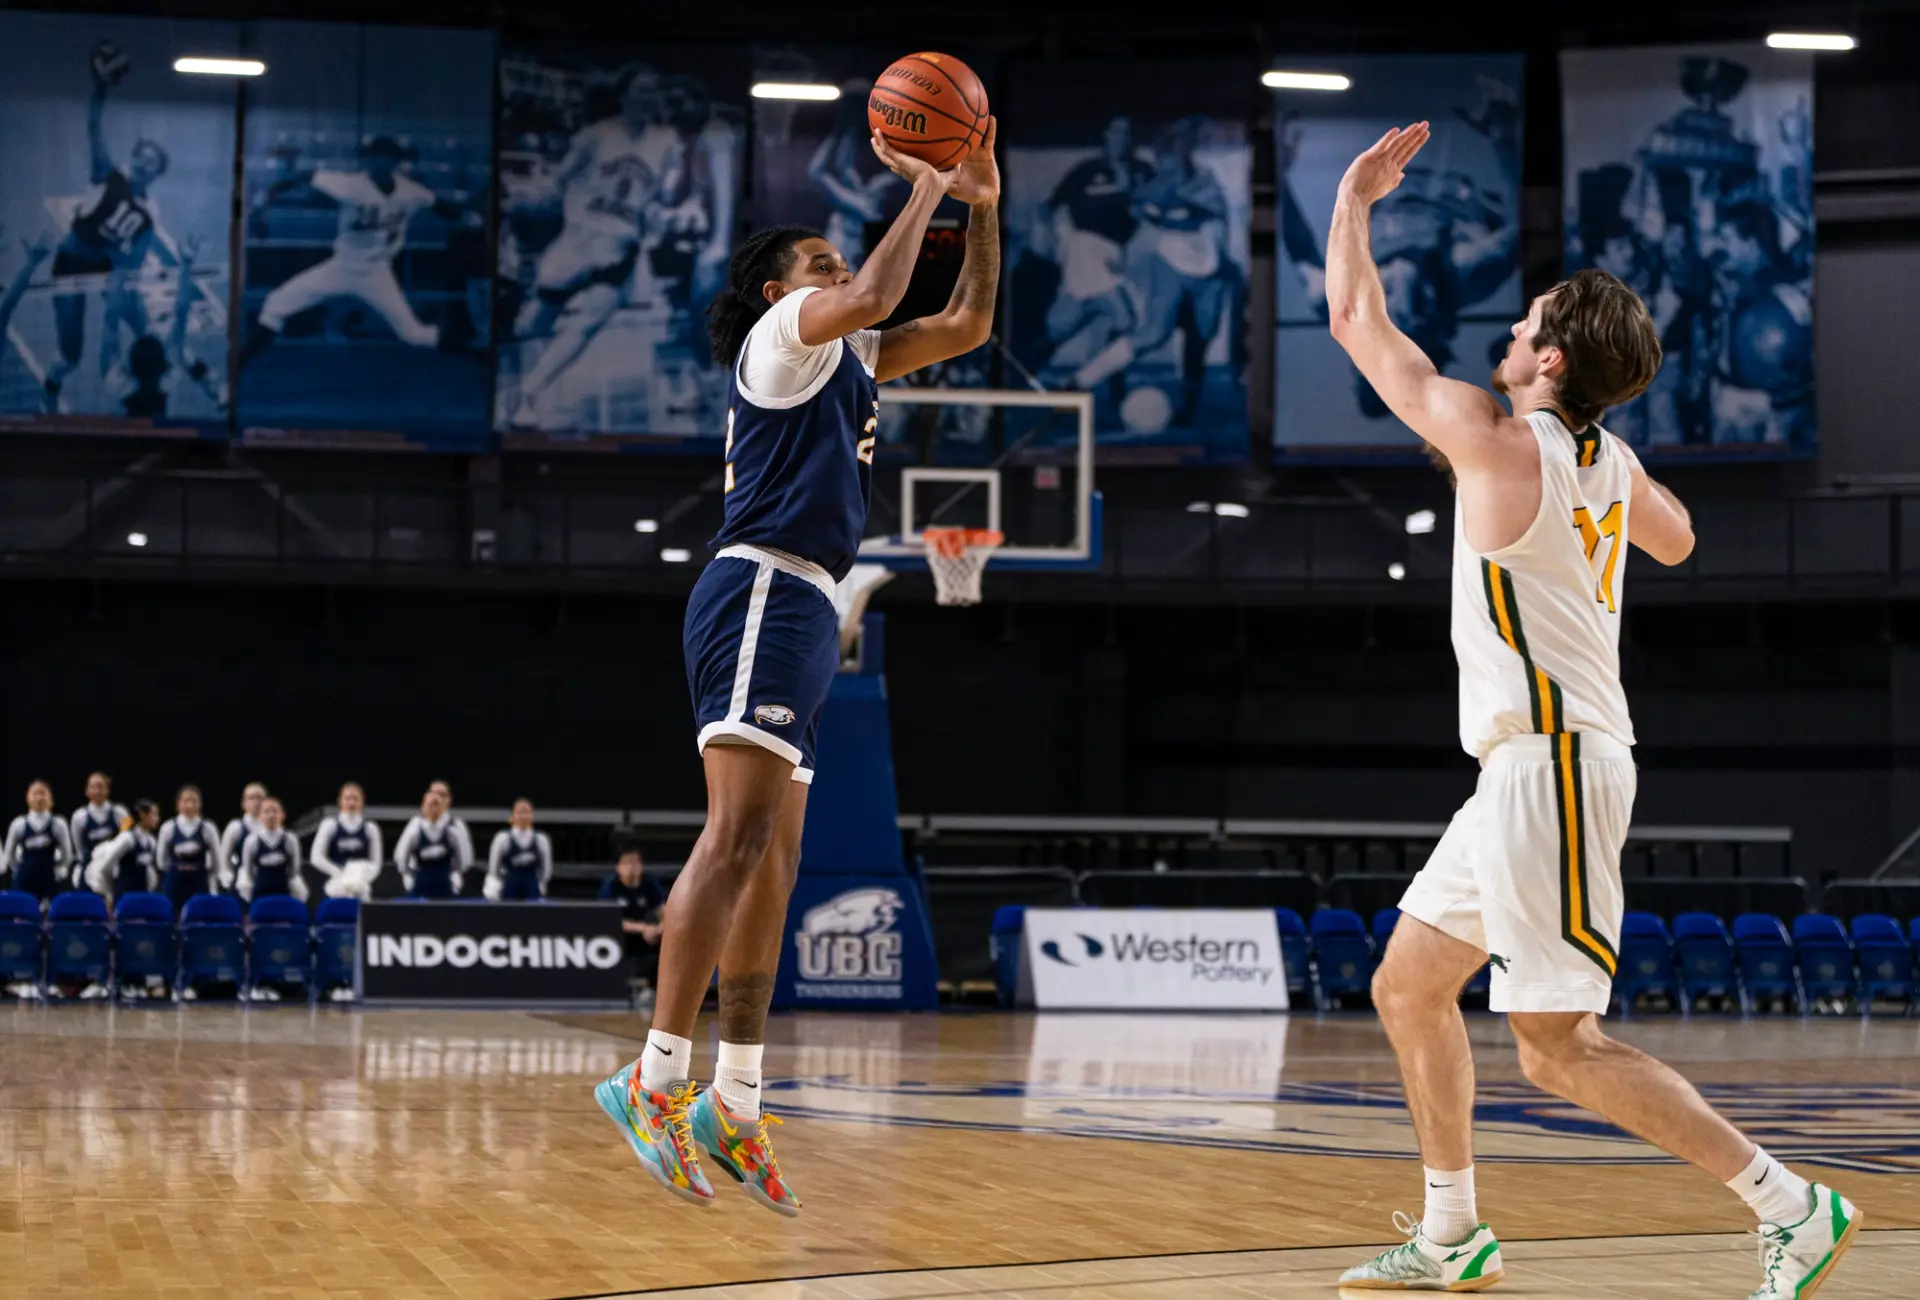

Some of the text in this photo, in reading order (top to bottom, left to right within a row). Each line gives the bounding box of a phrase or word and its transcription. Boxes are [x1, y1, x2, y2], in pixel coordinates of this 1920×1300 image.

[869, 95, 927, 134] Wilson
[366, 934, 622, 969] INDOCHINO
[795, 931, 902, 981] UBC
[1111, 932, 1260, 963] Western
[1190, 962, 1273, 986] Pottery
